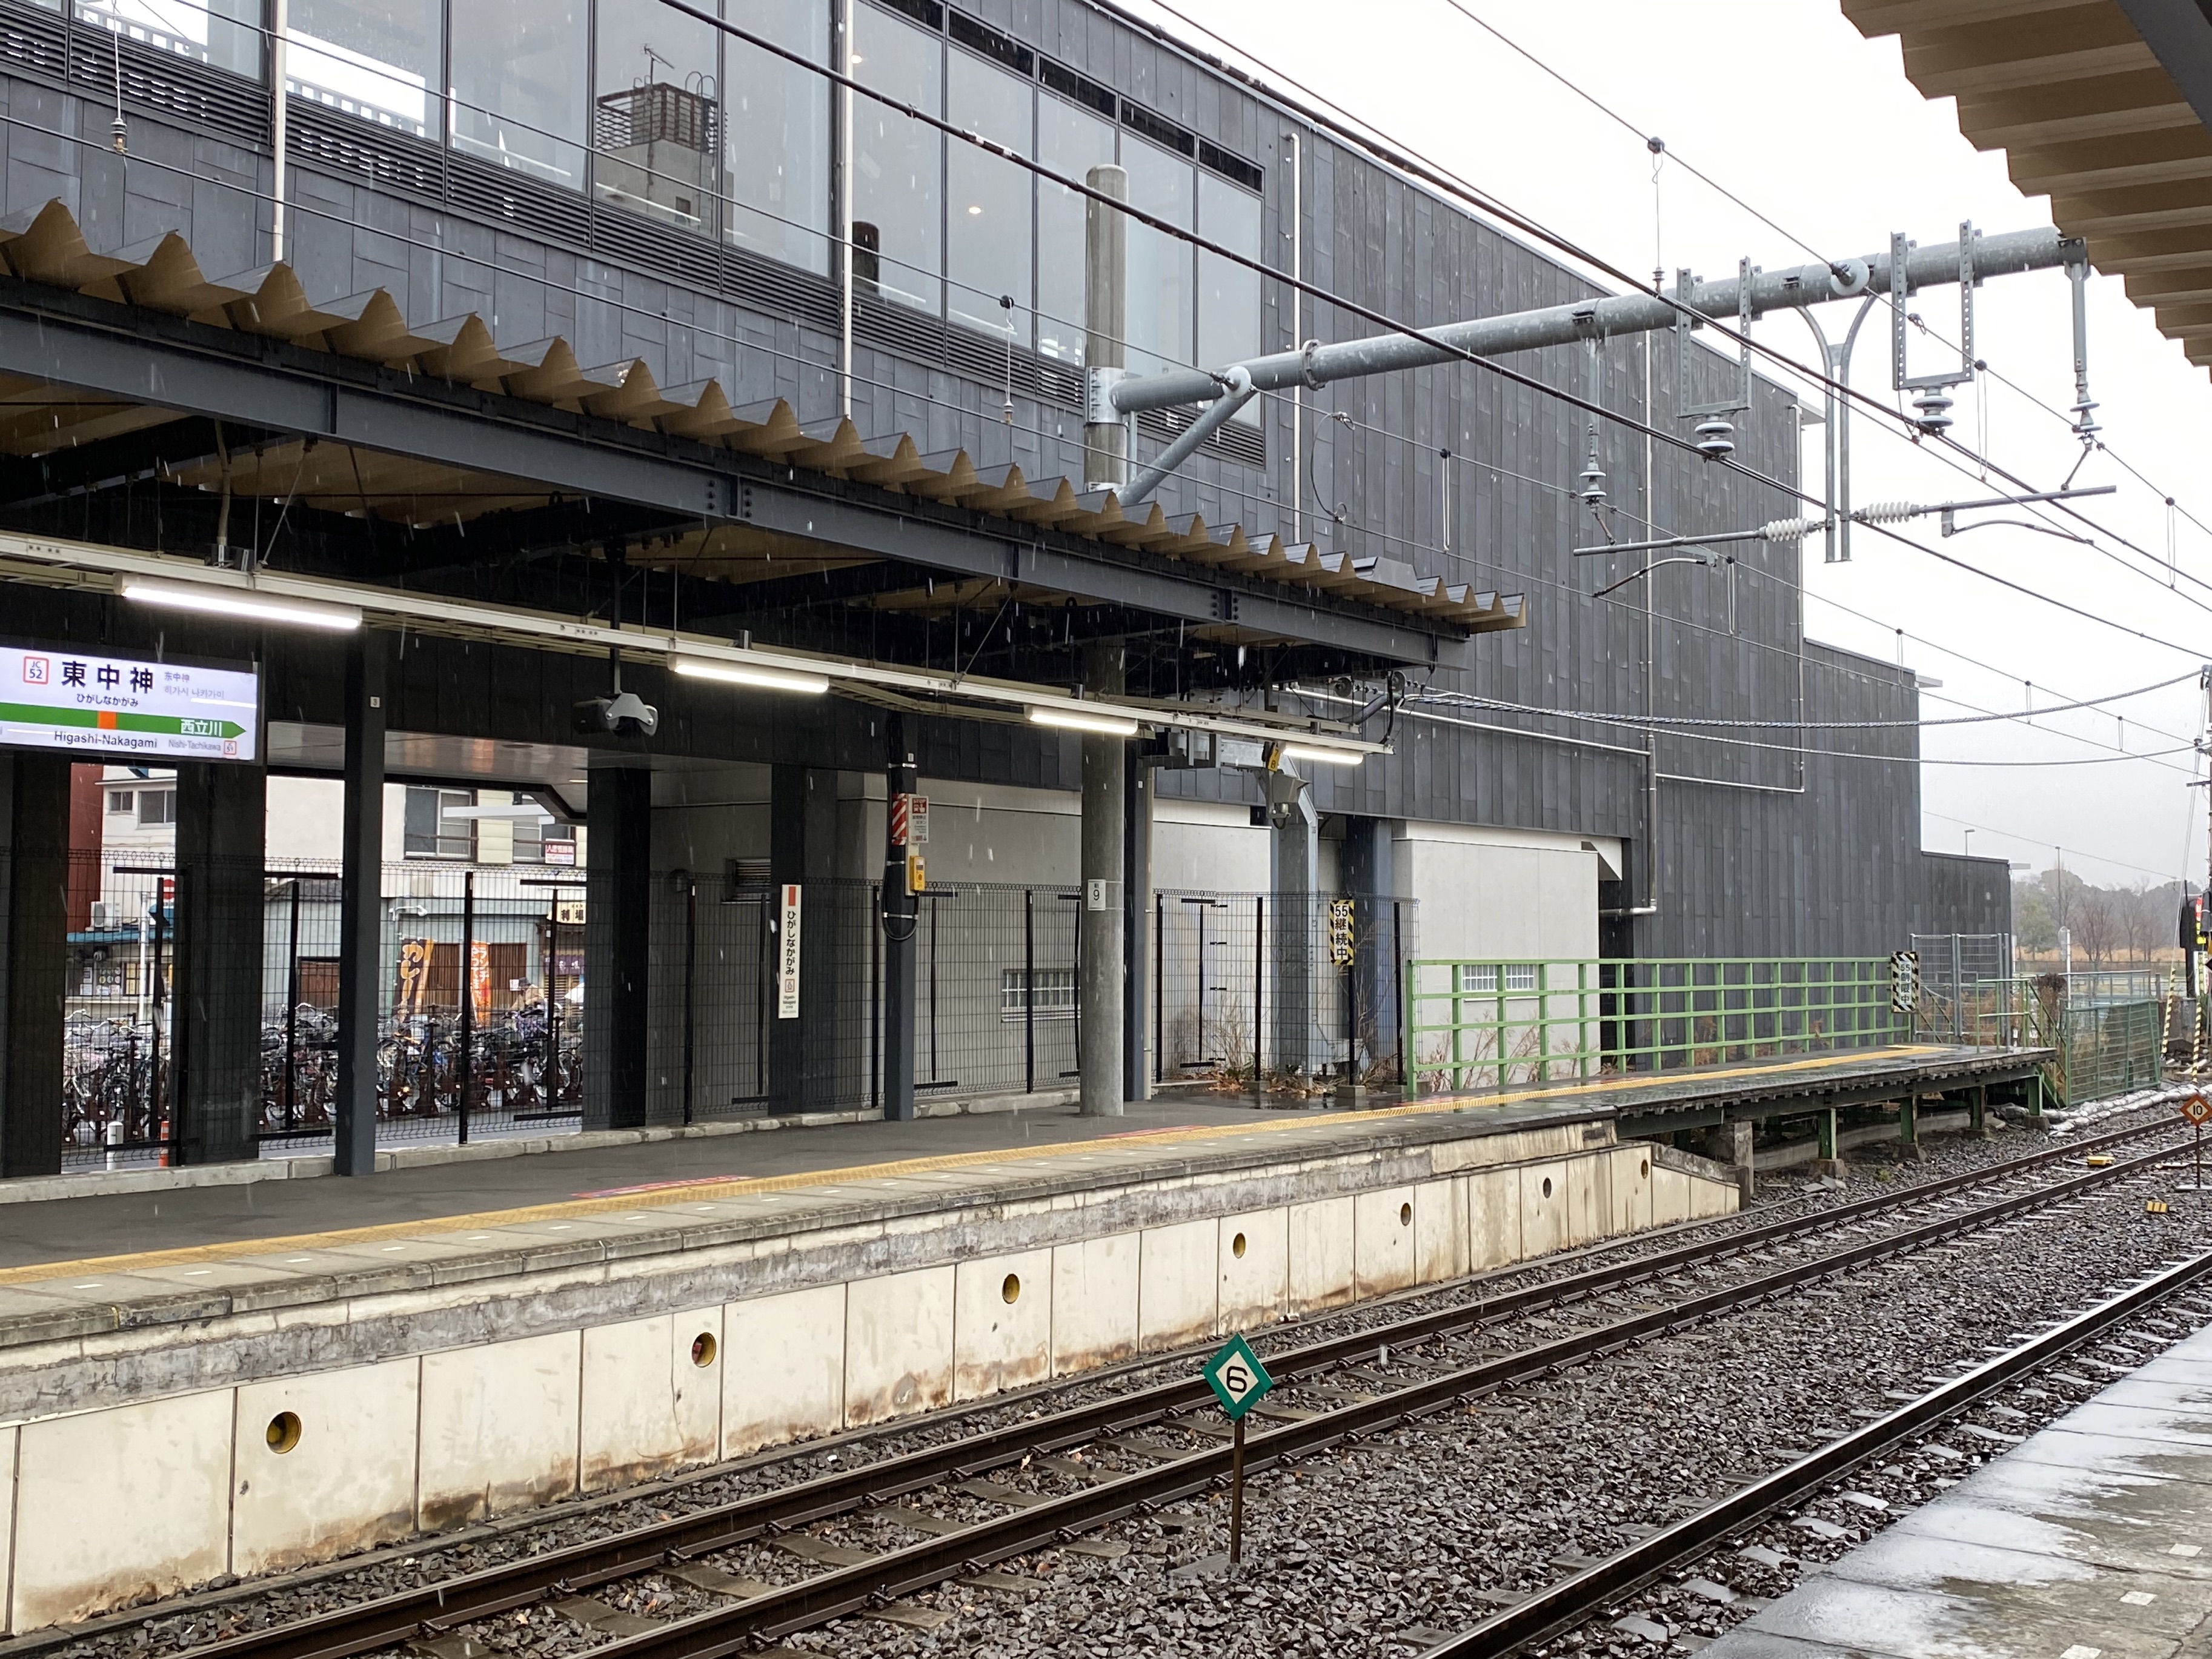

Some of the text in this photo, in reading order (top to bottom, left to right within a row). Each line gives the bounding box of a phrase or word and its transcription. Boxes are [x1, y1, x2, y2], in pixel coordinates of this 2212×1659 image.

[29, 669, 42, 679] 52
[61, 660, 153, 694] 東中神
[164, 671, 190, 683] 东中神
[164, 685, 225, 699] 히가시 나카가미
[76, 693, 139, 707] ひがしなかがみ
[181, 719, 222, 737] 西立川
[55, 731, 158, 749] Higashi-Nakagami
[168, 739, 221, 751] Nishi-Tachikawa
[1093, 889, 1100, 901] 9
[1335, 905, 1348, 960] 55継続中
[785, 911, 796, 976] ひがしなかがみ
[2193, 1105, 2203, 1115] 10
[1226, 1366, 1248, 1393] 6
